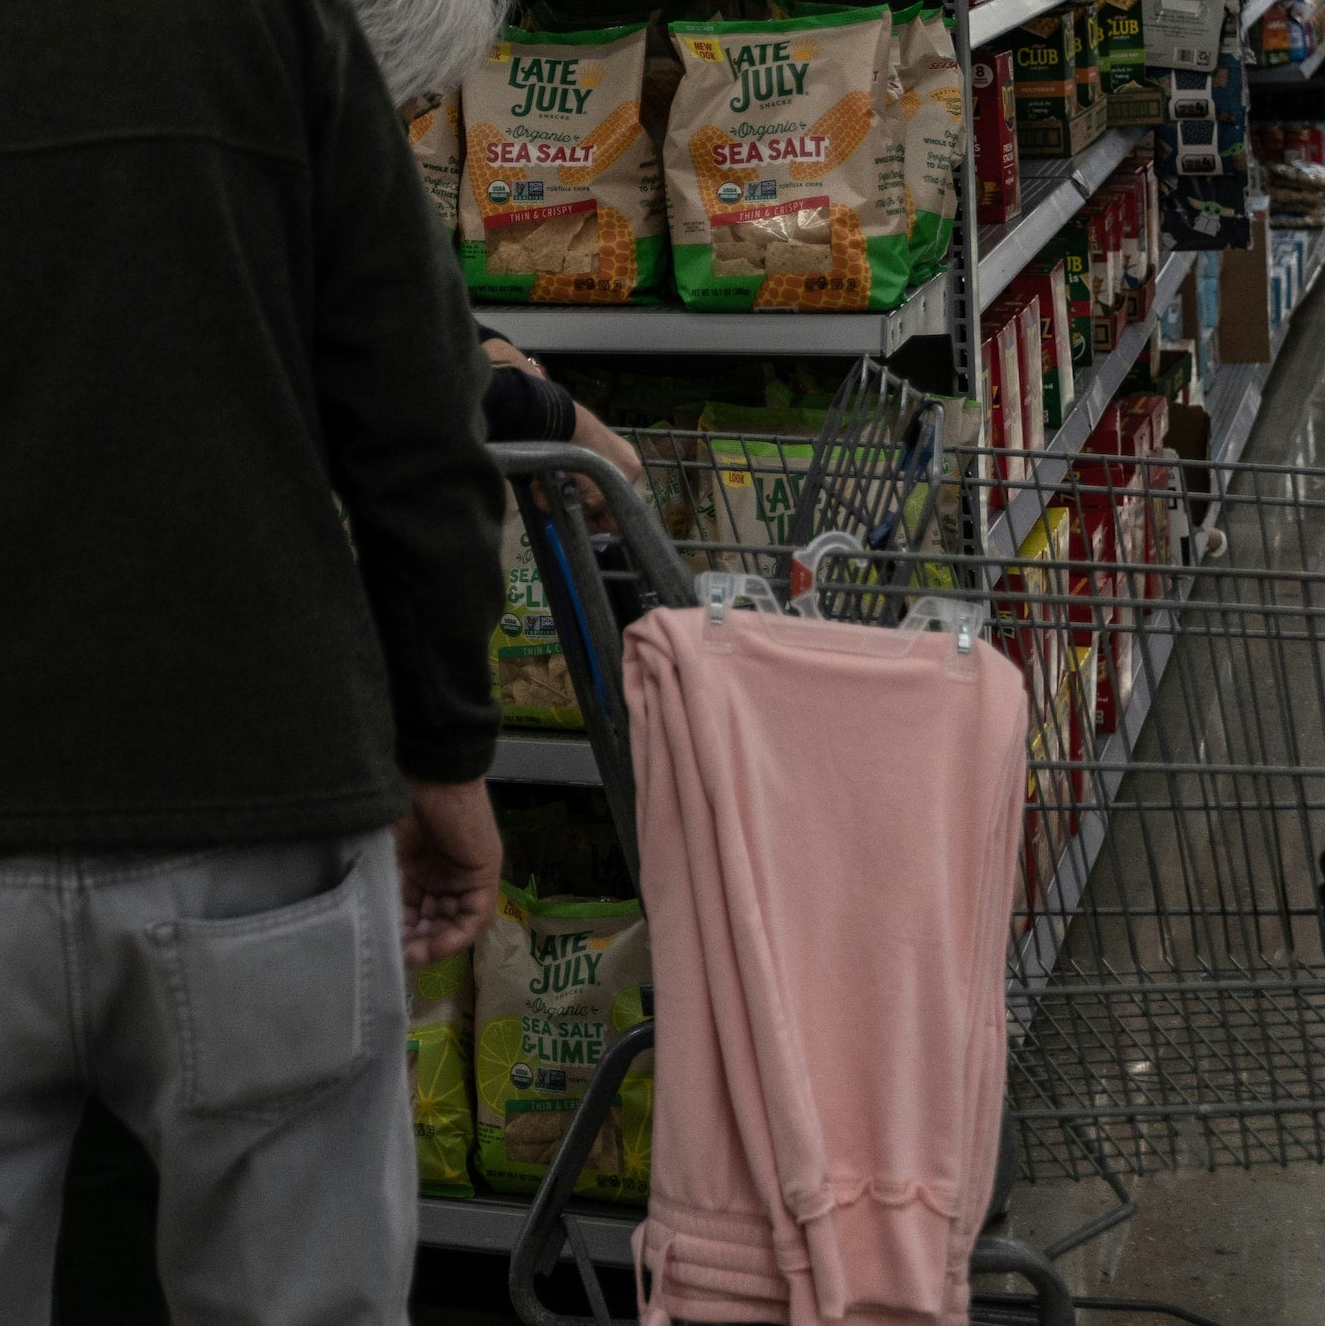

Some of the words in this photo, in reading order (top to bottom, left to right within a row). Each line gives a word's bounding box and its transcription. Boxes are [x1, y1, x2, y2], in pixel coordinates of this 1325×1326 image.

[694, 42, 712, 54] NEW
[726, 41, 790, 82] LATE
[1017, 47, 1059, 67] CLUB
[509, 57, 578, 88] LATE
[975, 65, 985, 76] 8
[512, 87, 593, 118] JULY
[730, 63, 808, 114] JULY
[737, 120, 798, 141] Organic
[486, 142, 531, 164] SEA
[537, 143, 595, 165] SALT
[712, 142, 762, 165] SEA
[767, 137, 826, 163] SALT
[530, 928, 593, 966] LATE
[529, 953, 601, 995] JULY
